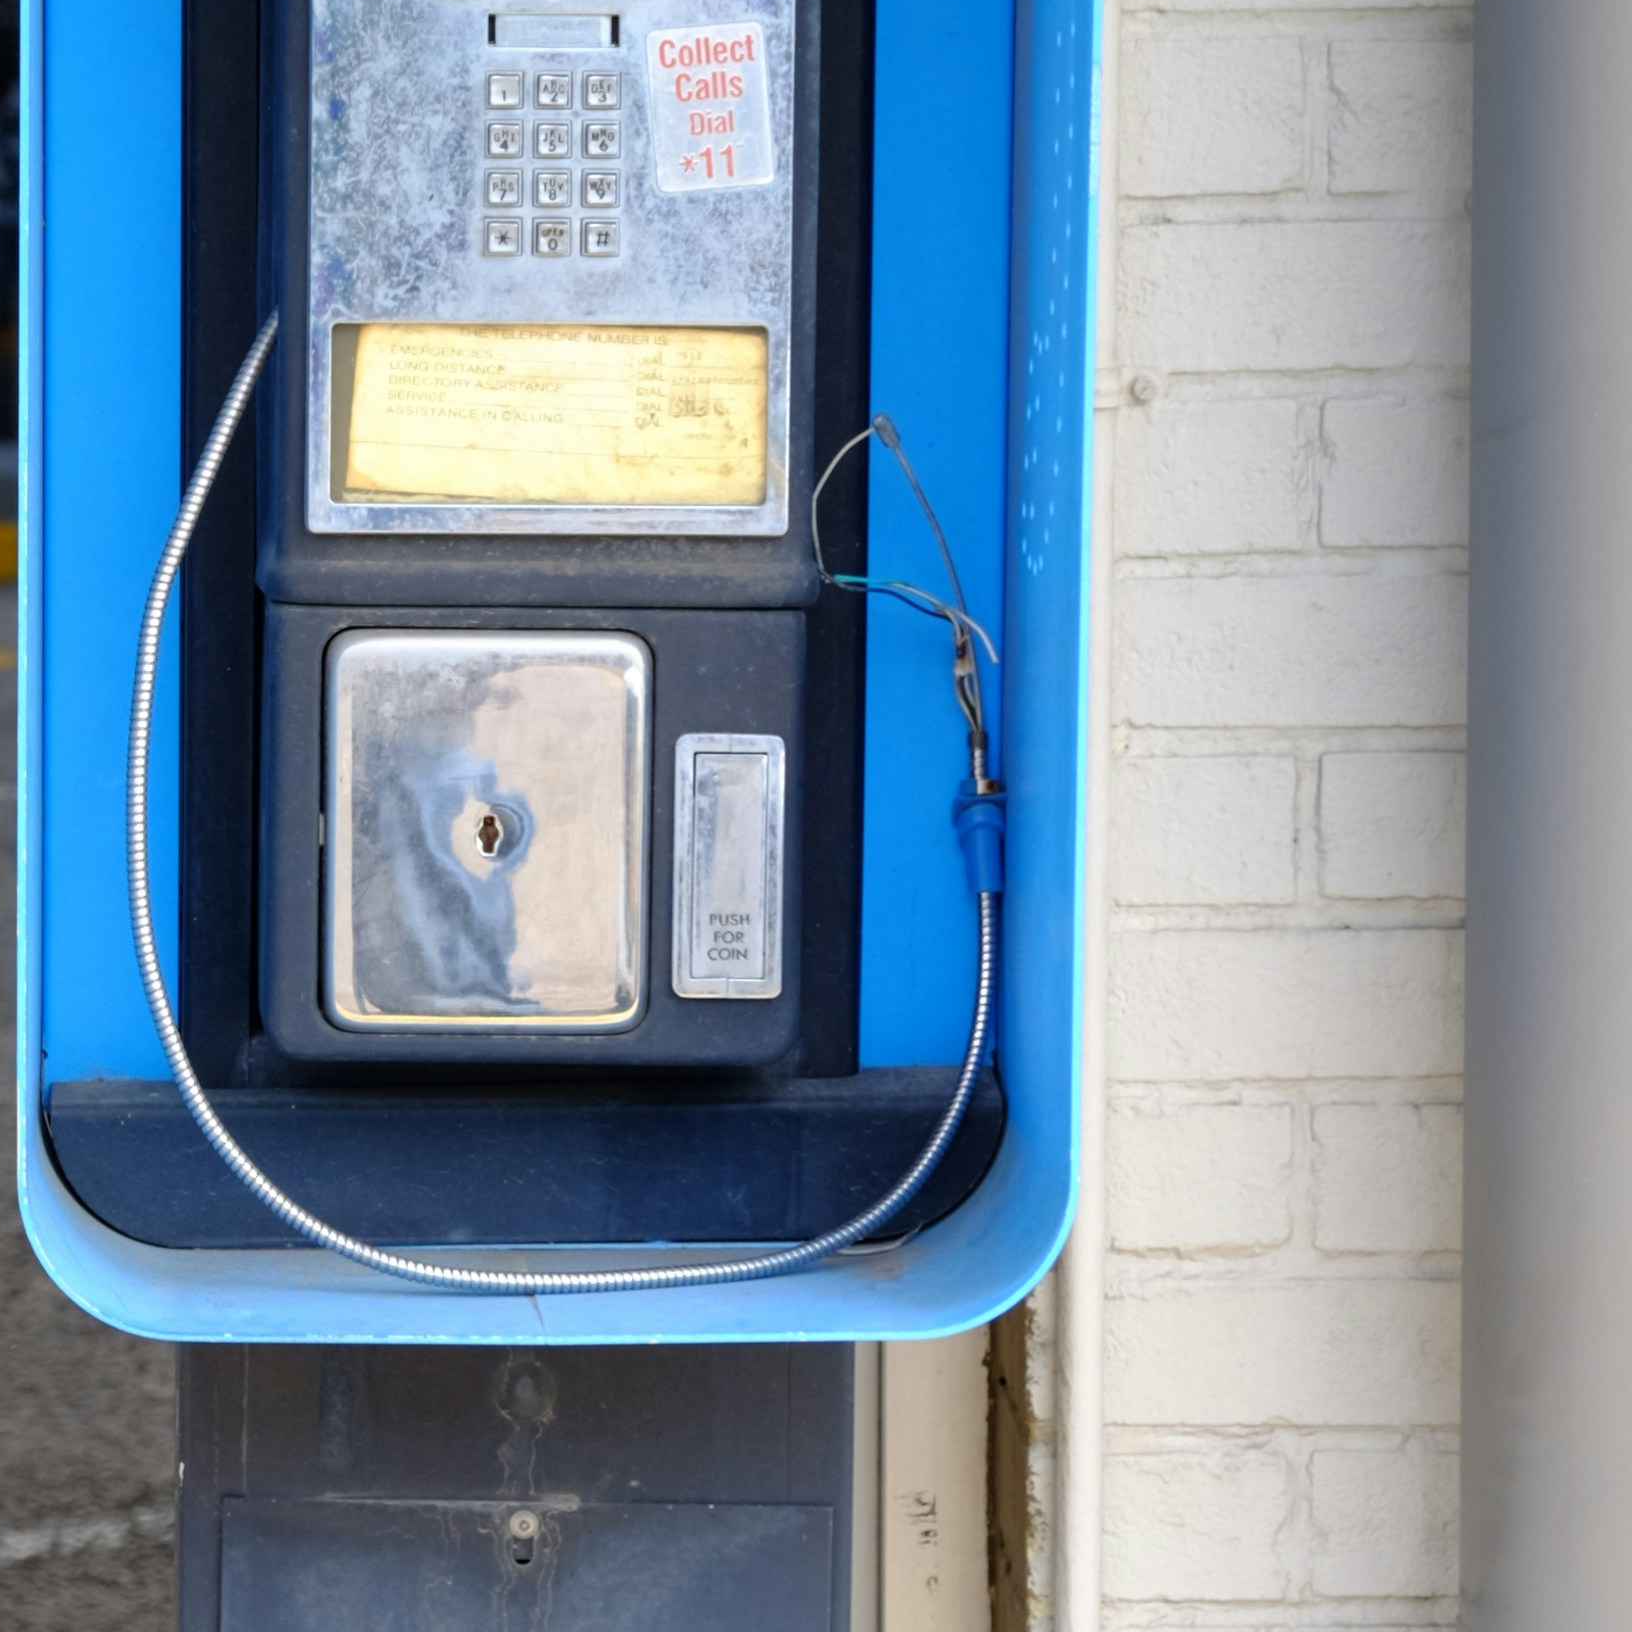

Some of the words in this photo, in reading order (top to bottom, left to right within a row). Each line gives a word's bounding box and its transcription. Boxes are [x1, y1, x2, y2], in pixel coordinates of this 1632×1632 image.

[658, 34, 755, 69] Collect
[674, 71, 744, 103] Calls
[501, 90, 507, 102] 1
[550, 92, 558, 103] 2
[598, 92, 607, 103] 3
[689, 109, 735, 136] Dial
[499, 139, 509, 152] 4
[548, 139, 557, 153] 5
[598, 139, 608, 152] 6
[499, 188, 508, 201] 7
[548, 188, 557, 201] 8
[595, 188, 605, 200] 9
[459, 327, 491, 340] THE
[494, 328, 582, 344] TELEPHONE
[586, 332, 650, 346] NUMBER
[390, 345, 493, 359] EMERGENCIES
[389, 360, 429, 372] LONG
[434, 361, 506, 376] DISTANCE
[388, 376, 471, 389] DIRECTORY
[474, 379, 564, 393] ASSISTANCE
[635, 386, 666, 398] DIAL
[388, 391, 448, 402] SERVICE
[636, 401, 665, 413] DIAL
[384, 405, 478, 419] ASSISTANCE
[482, 410, 497, 421] IN
[501, 411, 564, 425] CALLING
[708, 913, 751, 926] PUSH
[713, 930, 745, 944] FOR
[707, 947, 749, 961] COIN
